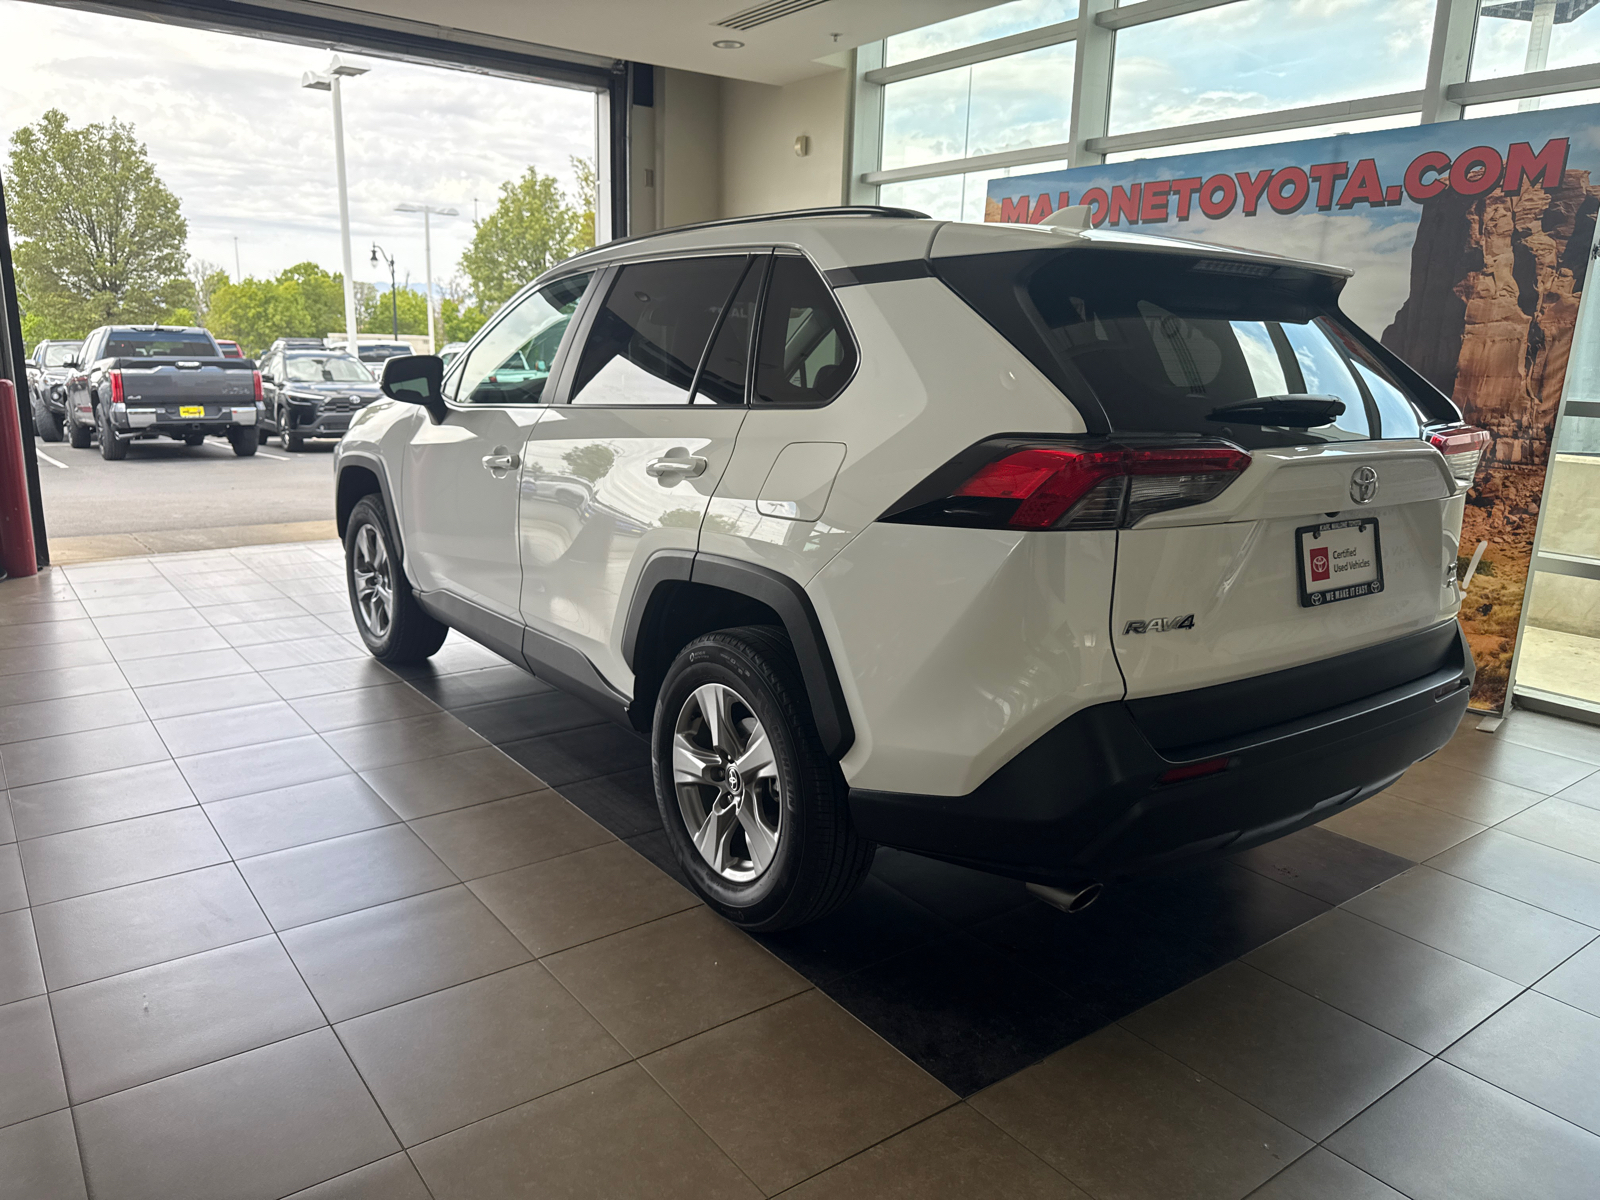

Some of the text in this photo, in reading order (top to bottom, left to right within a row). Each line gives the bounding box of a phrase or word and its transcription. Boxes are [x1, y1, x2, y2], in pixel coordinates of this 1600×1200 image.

[1332, 548, 1357, 560] Certified
[1333, 559, 1371, 573] Used Vehicles
[1325, 584, 1368, 601] WE MAKE IT EASY
[1122, 613, 1195, 635] RAV4
